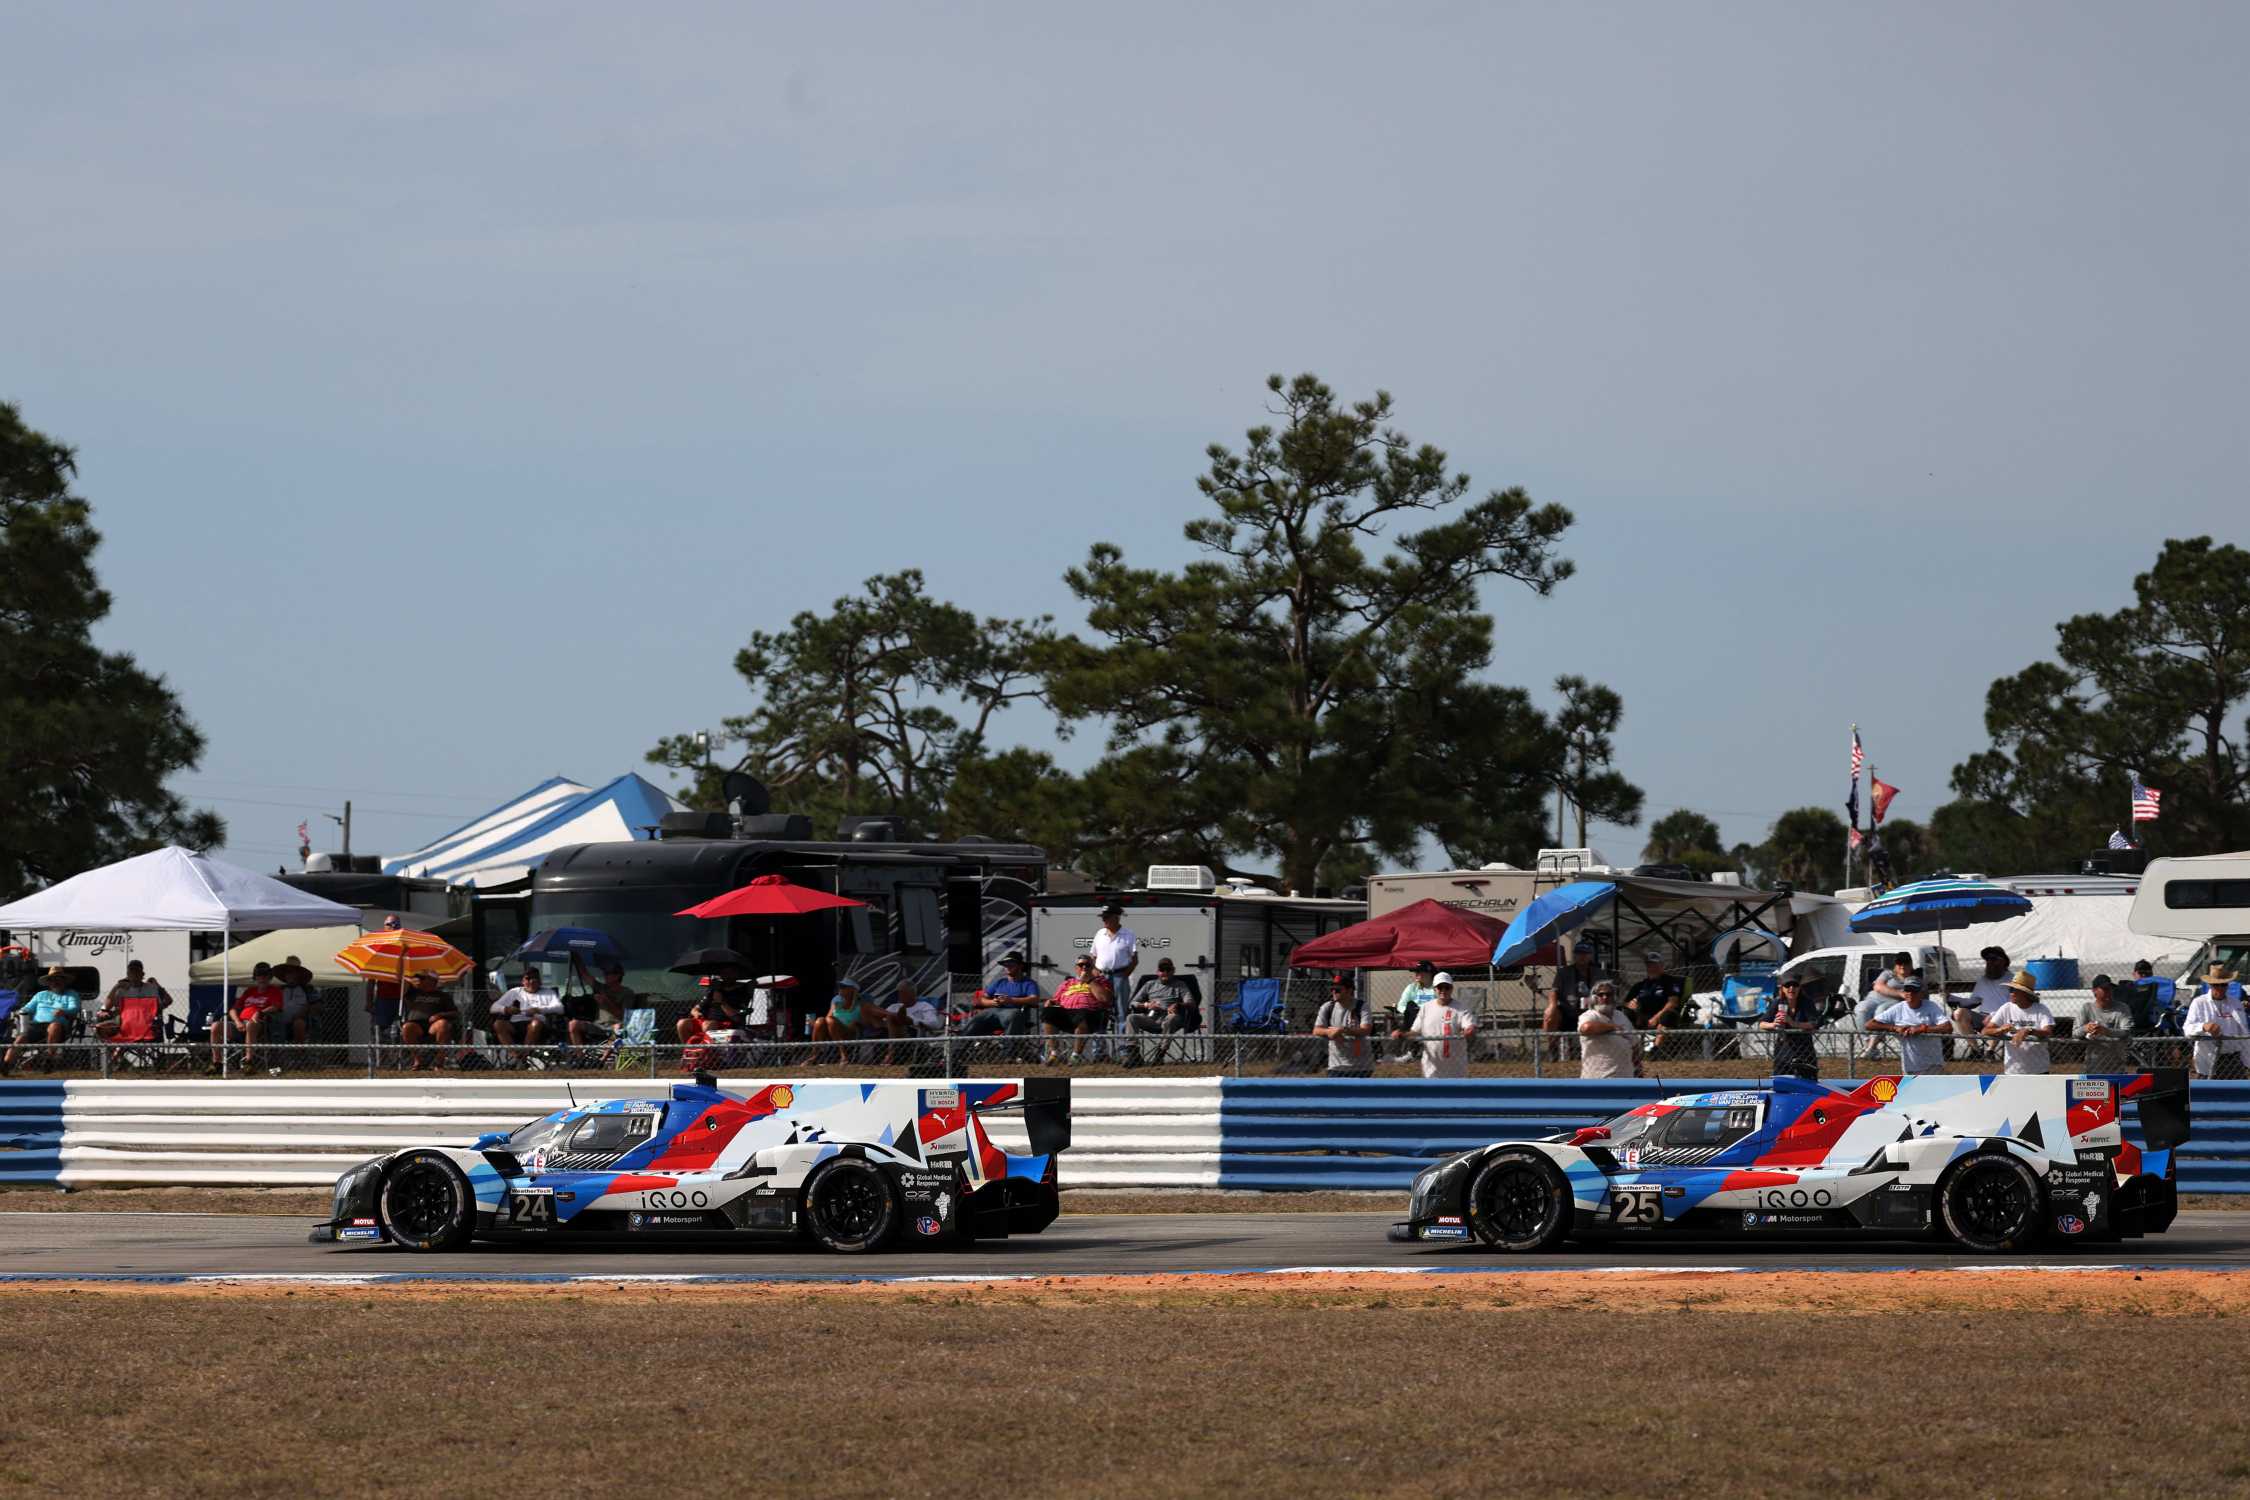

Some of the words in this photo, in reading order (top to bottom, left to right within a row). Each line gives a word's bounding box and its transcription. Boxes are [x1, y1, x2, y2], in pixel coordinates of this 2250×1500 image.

[58, 931, 133, 956] Imagine
[515, 1195, 549, 1221] 24
[641, 1190, 708, 1209] iQOO
[1615, 1192, 1661, 1223] 25
[1757, 1189, 1832, 1209] iQOO
[1438, 1216, 1461, 1224] MOTUL
[1779, 1215, 1823, 1223] Motorsport
